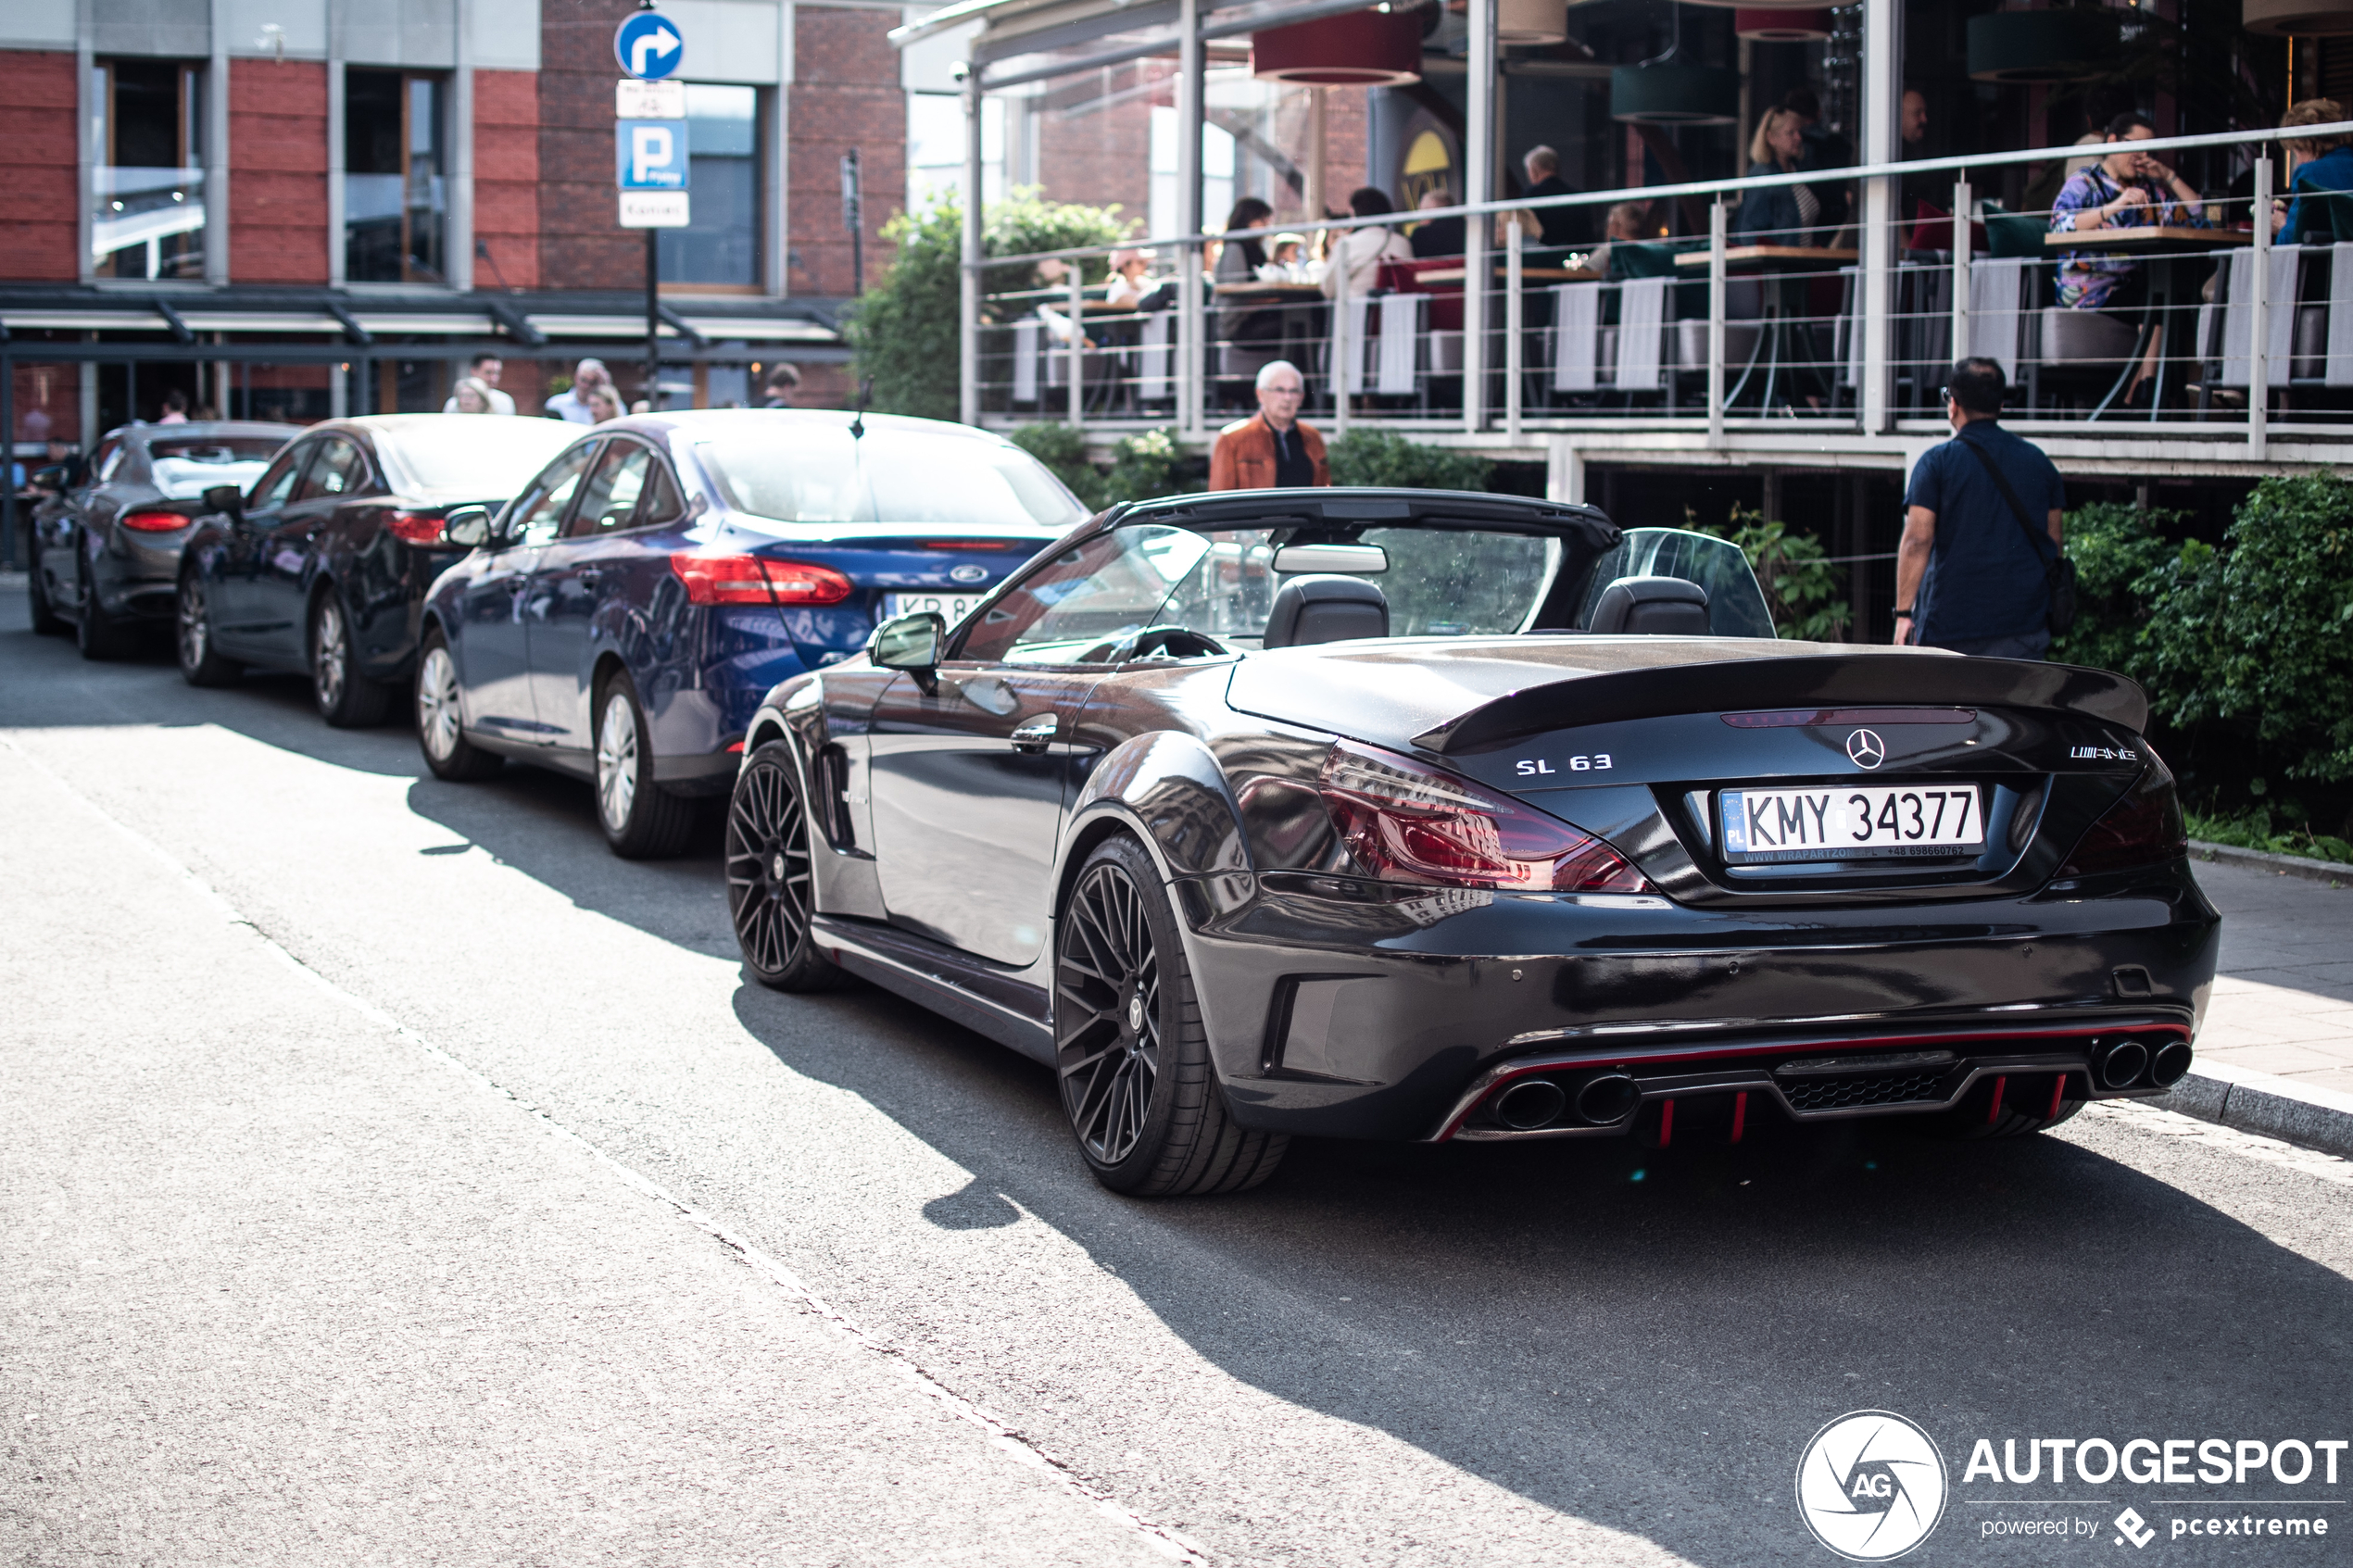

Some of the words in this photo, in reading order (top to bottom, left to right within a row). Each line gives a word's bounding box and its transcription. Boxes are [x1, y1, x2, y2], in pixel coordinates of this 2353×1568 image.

[633, 127, 673, 182] P
[1516, 759, 1555, 775] SL
[1569, 754, 1613, 771] 63
[1747, 795, 1830, 846] KMY
[1848, 791, 1972, 842] 34377
[1727, 830, 1744, 844] PL
[1888, 847, 1906, 856] +48
[1909, 846, 1965, 856] 698660762
